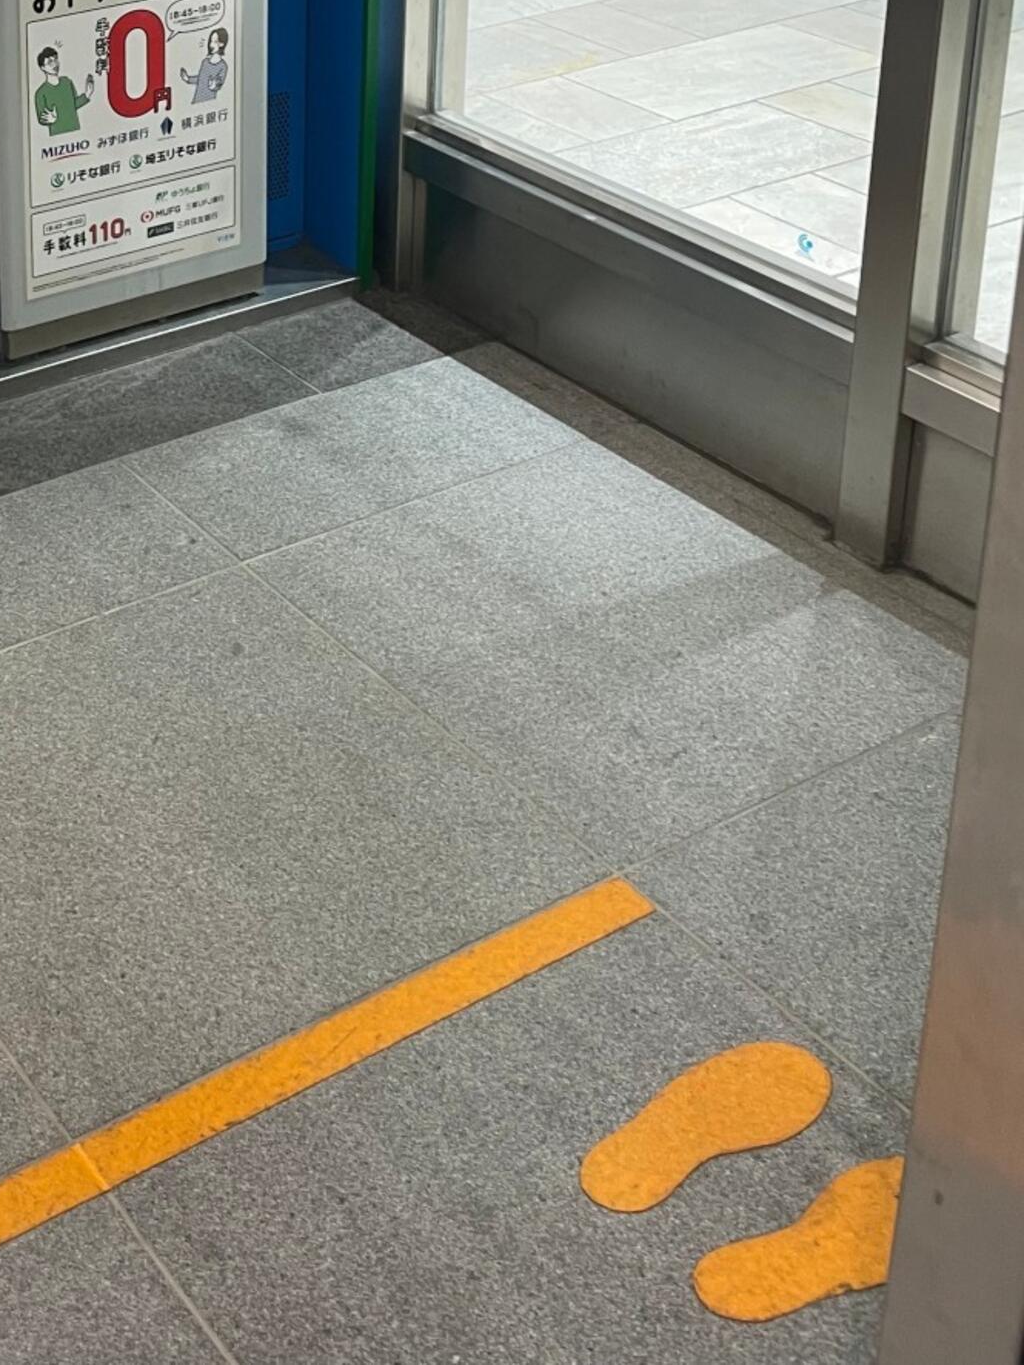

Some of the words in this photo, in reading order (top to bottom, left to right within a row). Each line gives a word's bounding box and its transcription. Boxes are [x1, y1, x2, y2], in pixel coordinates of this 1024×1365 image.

[107, 9, 172, 118] 0円
[181, 108, 229, 130] 横浜銀行
[41, 139, 90, 160] MIZUHO
[96, 127, 150, 150] みずほ銀行
[145, 138, 217, 165] 埼玉りそな銀行
[67, 160, 122, 185] りそな銀行
[43, 218, 131, 255] 手数料110円
